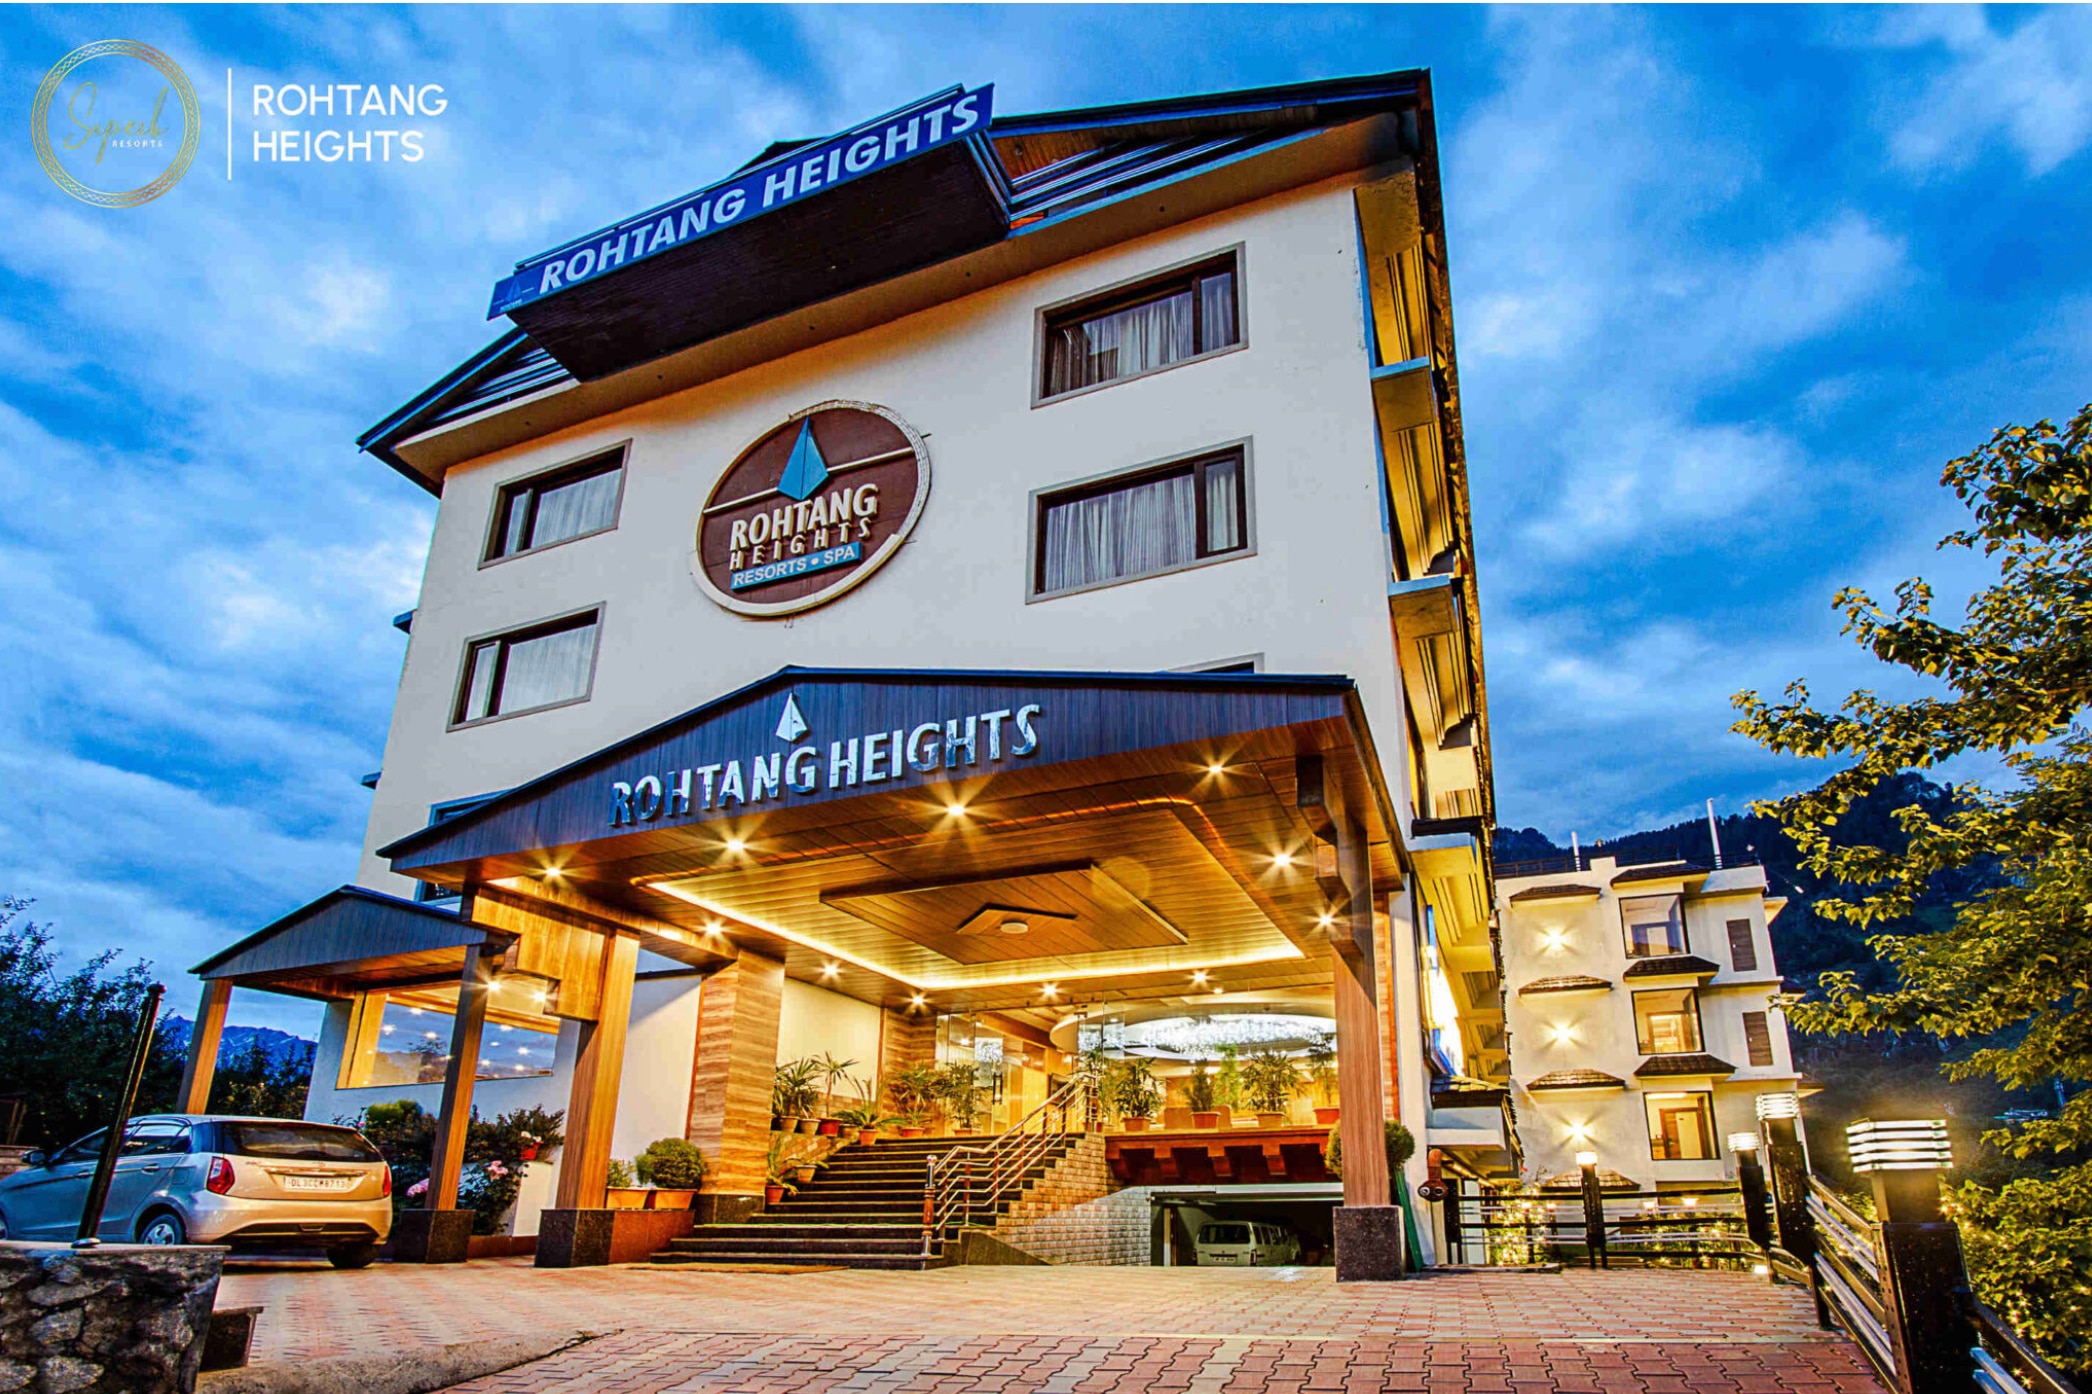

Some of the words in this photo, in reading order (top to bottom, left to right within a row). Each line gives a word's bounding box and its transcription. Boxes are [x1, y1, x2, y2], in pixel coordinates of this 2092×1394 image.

[539, 187, 747, 294] ROHTANG
[762, 94, 979, 208] HEIGHTS
[729, 516, 872, 571] HEIGHTS
[730, 483, 879, 553] ROHTANG
[733, 555, 807, 587] RESORTS
[823, 545, 856, 566] SPA
[607, 746, 818, 827] ROHTANG
[828, 703, 1042, 789] HEIGHTS
